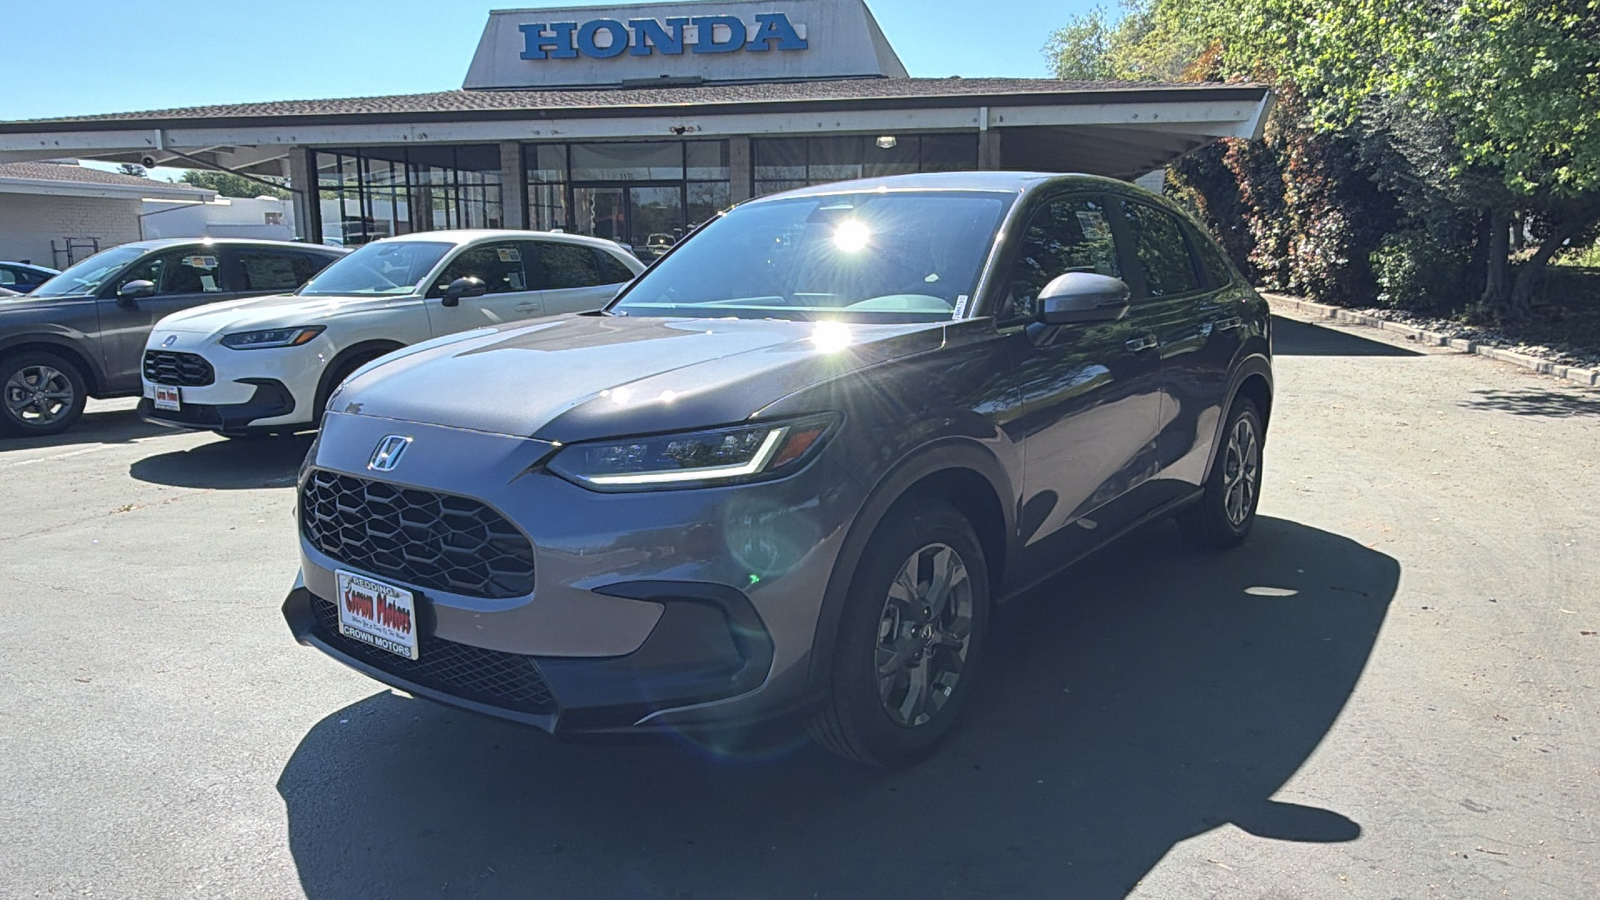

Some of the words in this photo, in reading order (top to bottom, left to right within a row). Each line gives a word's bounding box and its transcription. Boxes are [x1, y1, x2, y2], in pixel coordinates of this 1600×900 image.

[519, 12, 808, 60] HONDA
[353, 578, 393, 595] REDDING
[377, 592, 411, 634] Motors
[344, 626, 373, 642] CROWN
[375, 637, 410, 656] MOTORS
